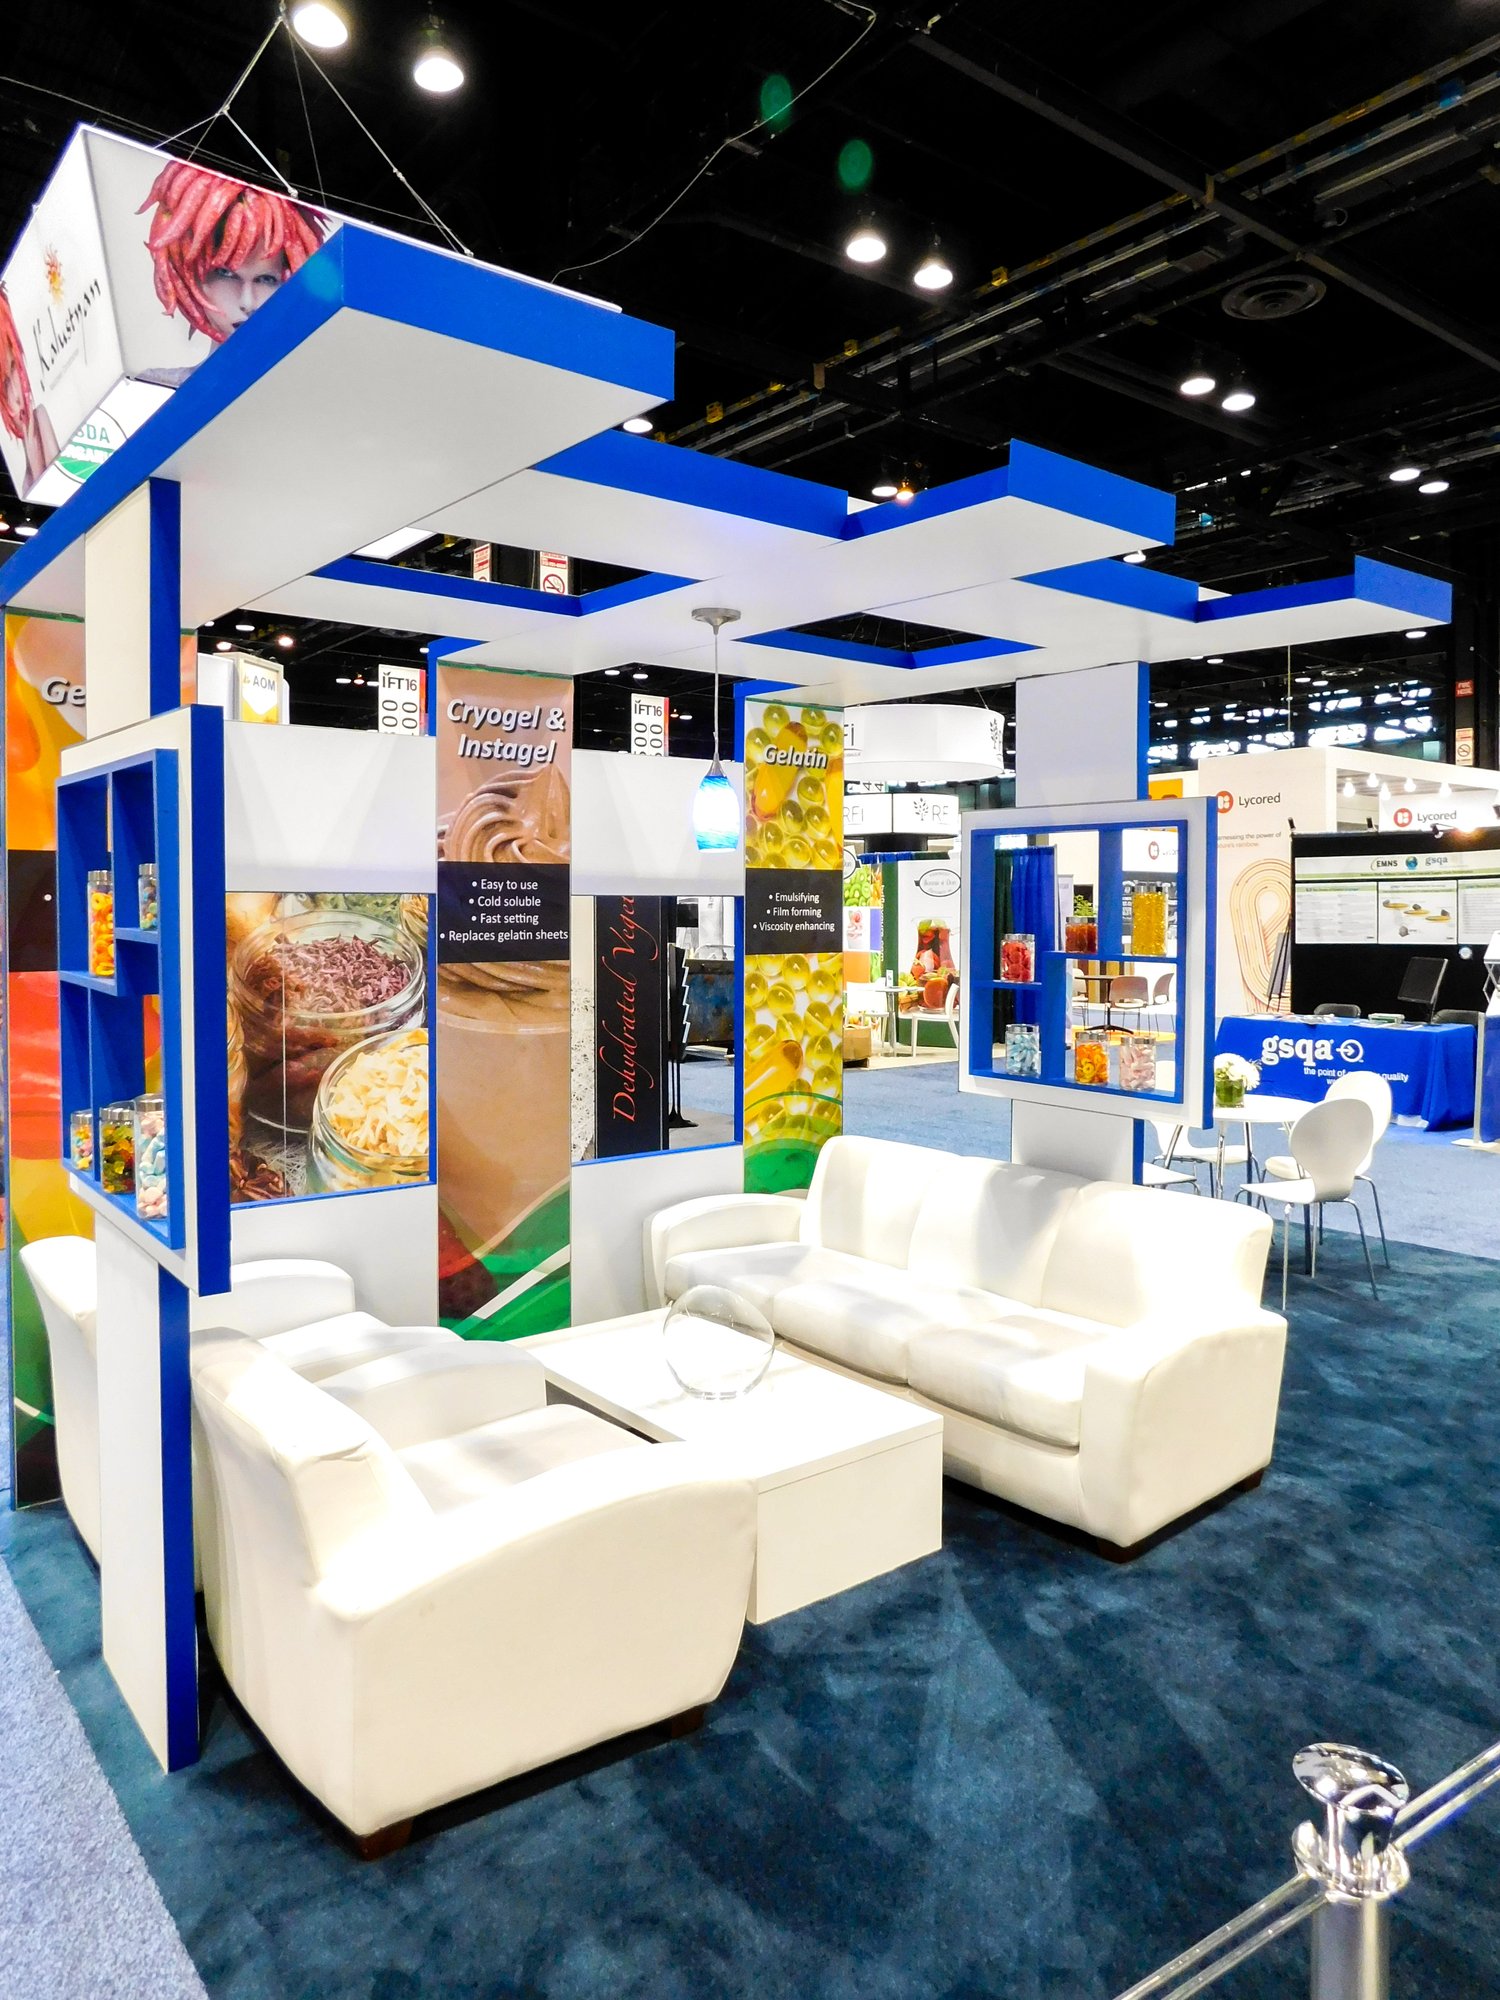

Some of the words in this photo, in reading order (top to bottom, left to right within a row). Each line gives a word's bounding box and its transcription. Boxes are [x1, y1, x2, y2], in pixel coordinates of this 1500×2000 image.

[253, 675, 276, 691] AOM
[447, 698, 542, 732] Cryogel
[546, 707, 566, 731] &
[458, 733, 557, 767] Instagel
[764, 744, 828, 769] Gelatin
[1238, 792, 1281, 808] Lycored
[1417, 810, 1457, 823] Lycored
[1376, 859, 1398, 868] EMNS
[1425, 856, 1448, 866] gsqa
[480, 878, 504, 892] Easy
[506, 880, 518, 890] to
[520, 881, 539, 890] use
[477, 895, 501, 907] Cold
[503, 895, 541, 907] soluble
[775, 892, 820, 904] Emulsifying
[773, 907, 790, 917] Film
[791, 906, 822, 918] forming
[480, 913, 502, 924] Fast
[503, 913, 540, 926] setting
[759, 921, 794, 933] Viscosity
[794, 921, 835, 933] enhancing
[448, 929, 496, 943] Replaces
[497, 929, 533, 943] gelatin
[535, 929, 569, 941] sheets
[599, 955, 655, 1122] Dehydrated
[1261, 1034, 1334, 1067] gsqa
[1303, 1067, 1317, 1076] the
[1317, 1068, 1336, 1078] point
[1337, 1069, 1346, 1077] of
[1381, 1073, 1409, 1083] quality
